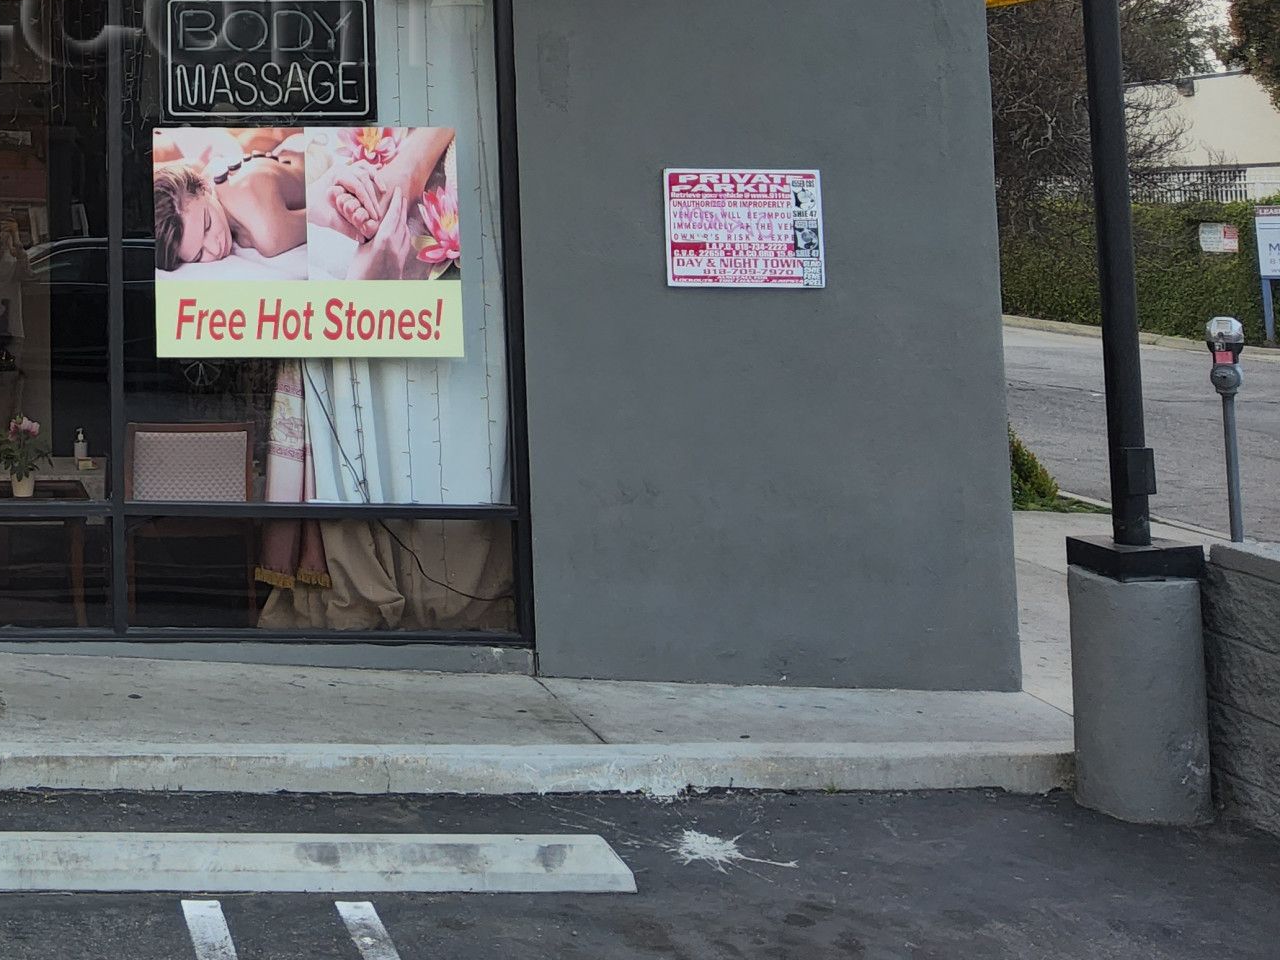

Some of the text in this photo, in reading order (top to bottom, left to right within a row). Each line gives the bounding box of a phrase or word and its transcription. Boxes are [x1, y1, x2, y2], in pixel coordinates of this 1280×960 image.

[178, 10, 353, 52] BODY
[177, 61, 359, 107] MASSAGE
[671, 183, 791, 193] PARKIN
[672, 200, 725, 208] UNAUTHORIZED
[721, 211, 741, 219] WILL
[676, 258, 804, 268] DAY & NIGHT TOWIN
[175, 297, 443, 341] Free Hot Stones!
